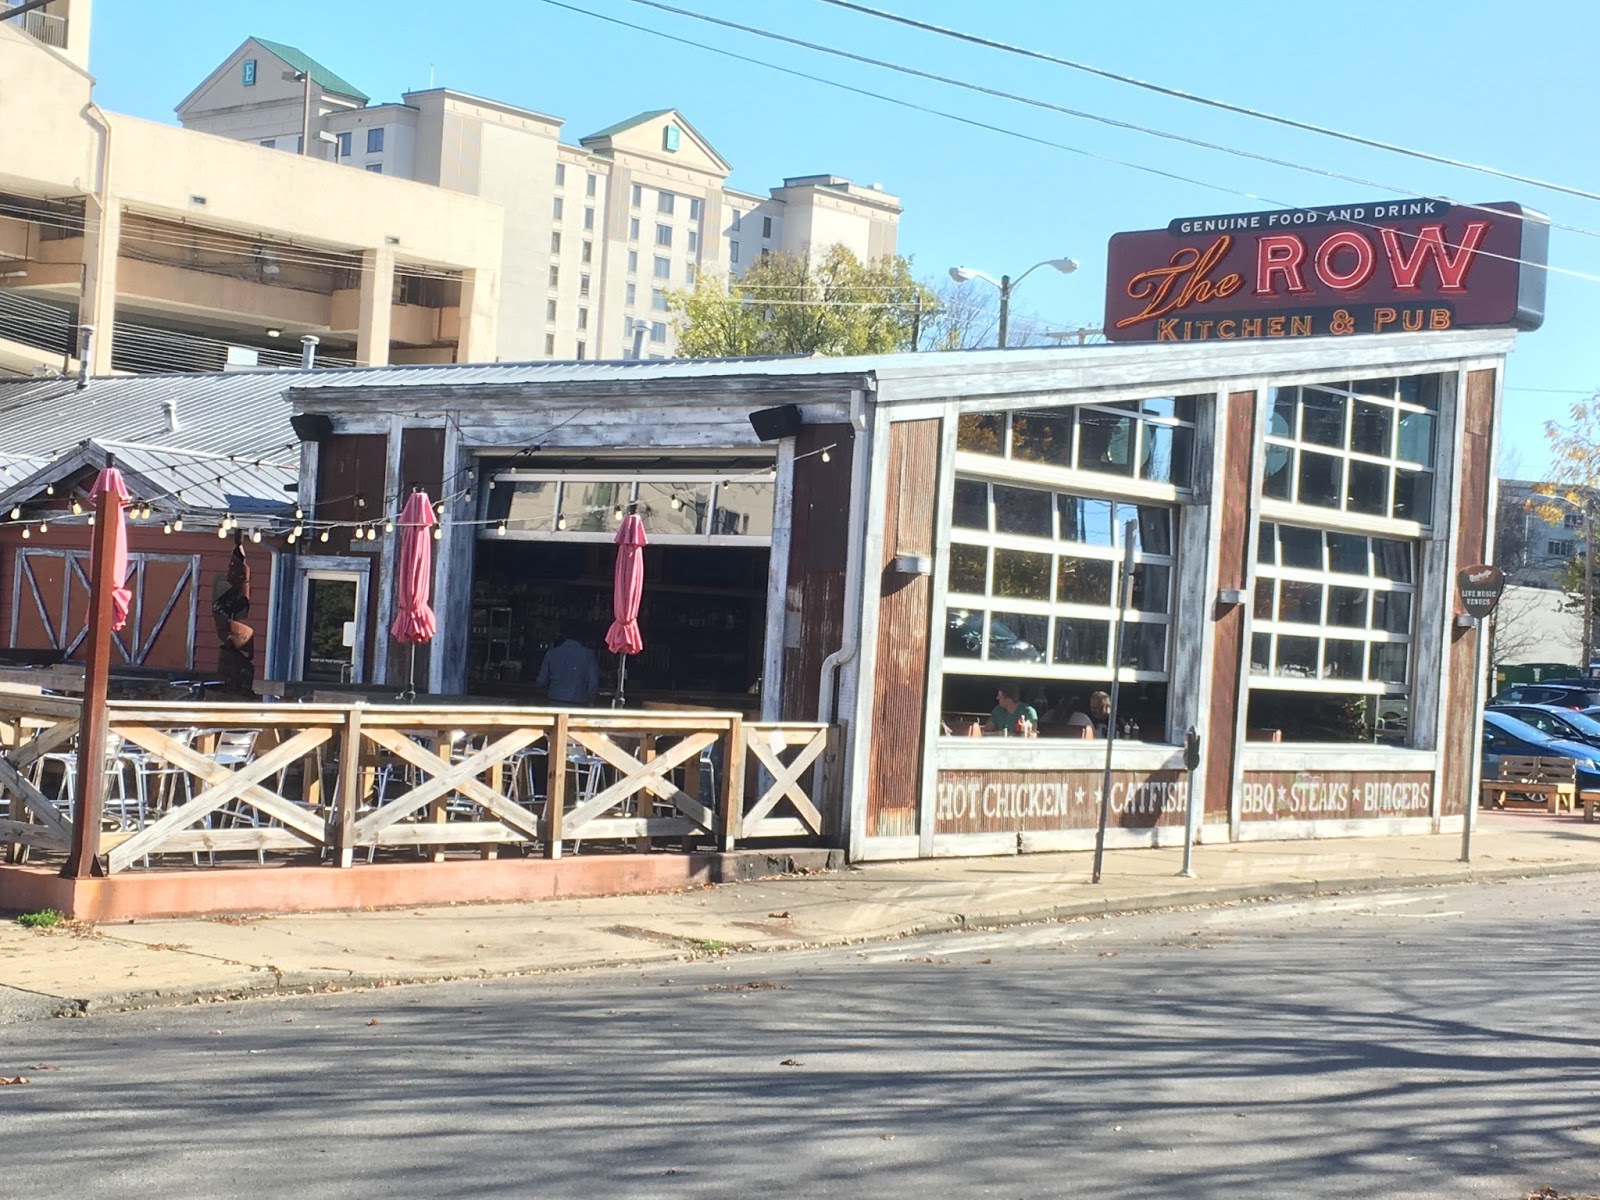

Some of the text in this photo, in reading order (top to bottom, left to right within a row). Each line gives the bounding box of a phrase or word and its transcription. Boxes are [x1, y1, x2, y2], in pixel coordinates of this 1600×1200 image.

[1180, 202, 1437, 233] GENUINE FOOD AND DRINK
[1116, 221, 1492, 328] The ROW
[1157, 307, 1453, 342] KITCHEN & PUB
[937, 781, 1188, 820] HOT CHICKEN CATFISH
[1242, 782, 1430, 813] BBQ STEAKS BURGERS
